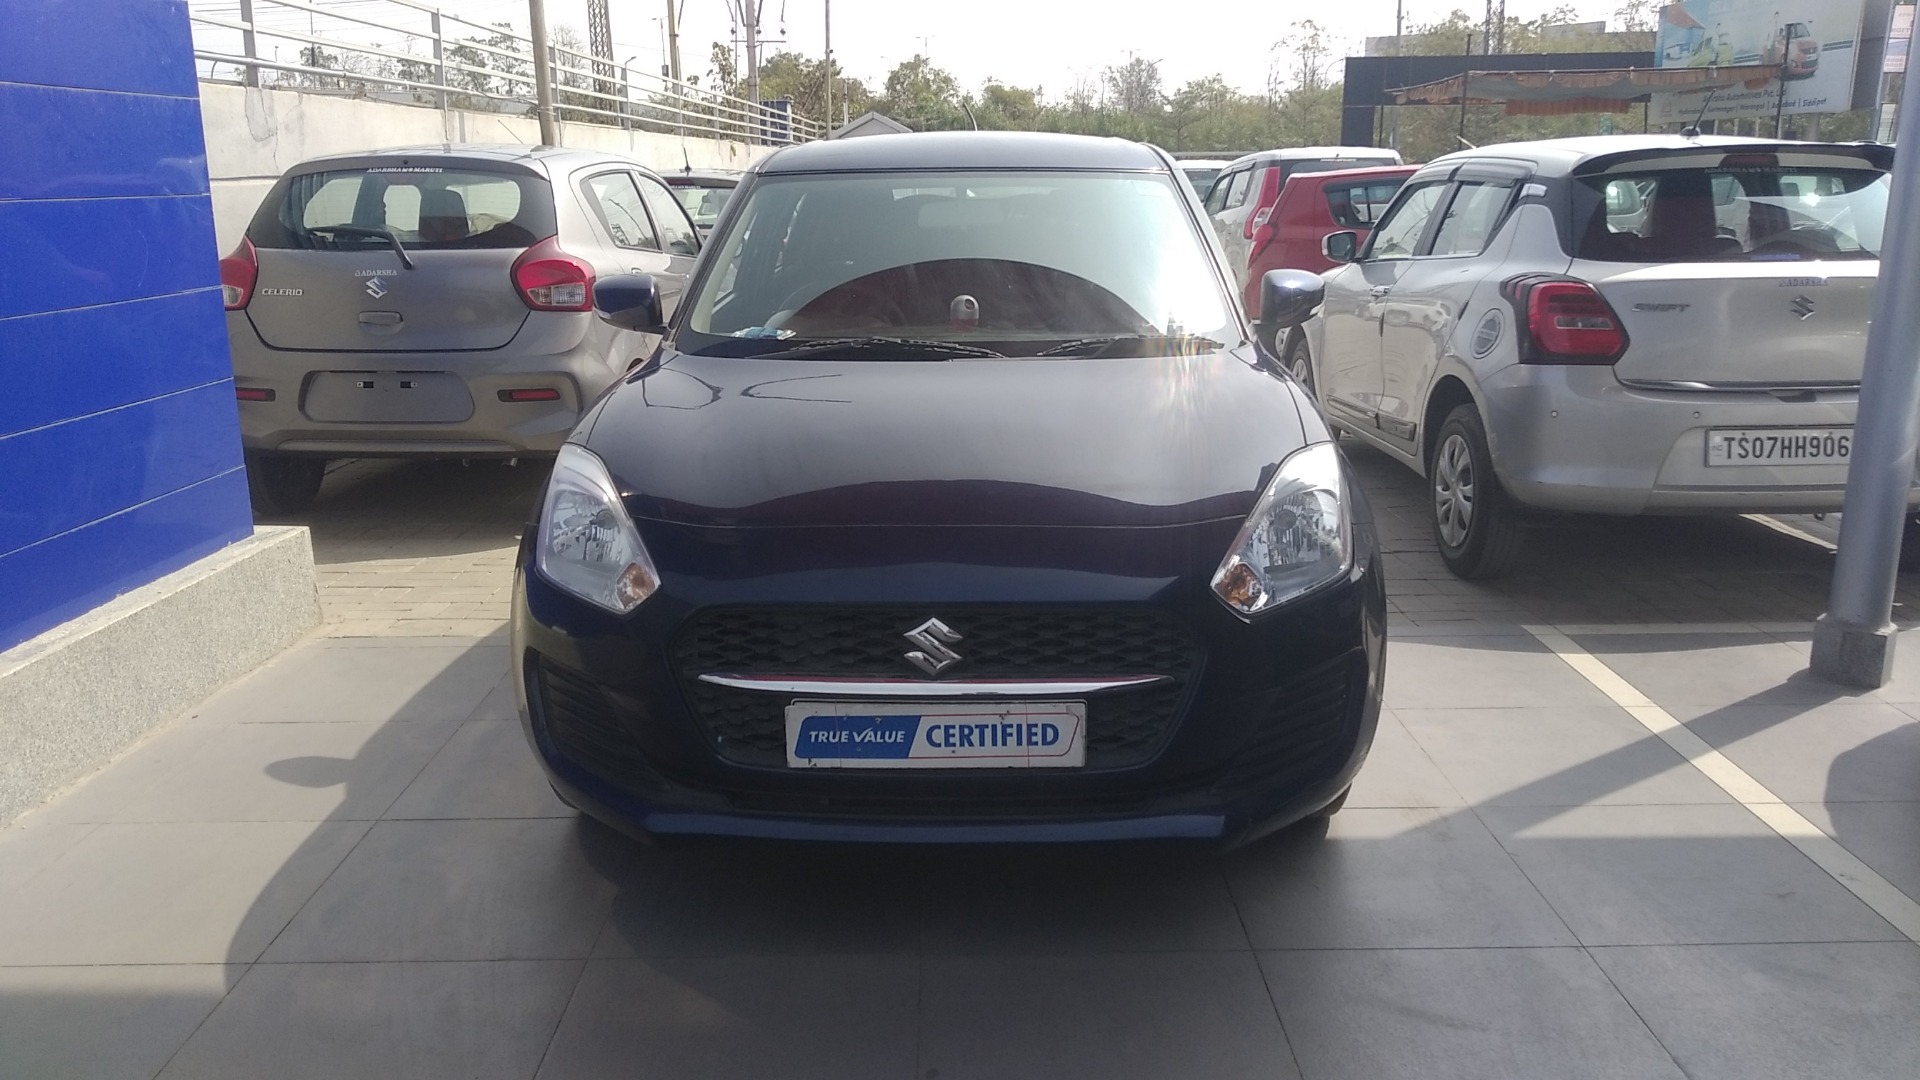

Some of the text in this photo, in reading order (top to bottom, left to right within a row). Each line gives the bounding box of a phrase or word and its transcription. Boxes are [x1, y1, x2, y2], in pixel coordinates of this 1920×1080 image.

[361, 269, 398, 277] ADARSHA
[261, 288, 303, 296] CELERIO
[1723, 435, 1850, 459] TS07HH906
[809, 722, 1060, 748] TRUE VALUE CERTIFIED
